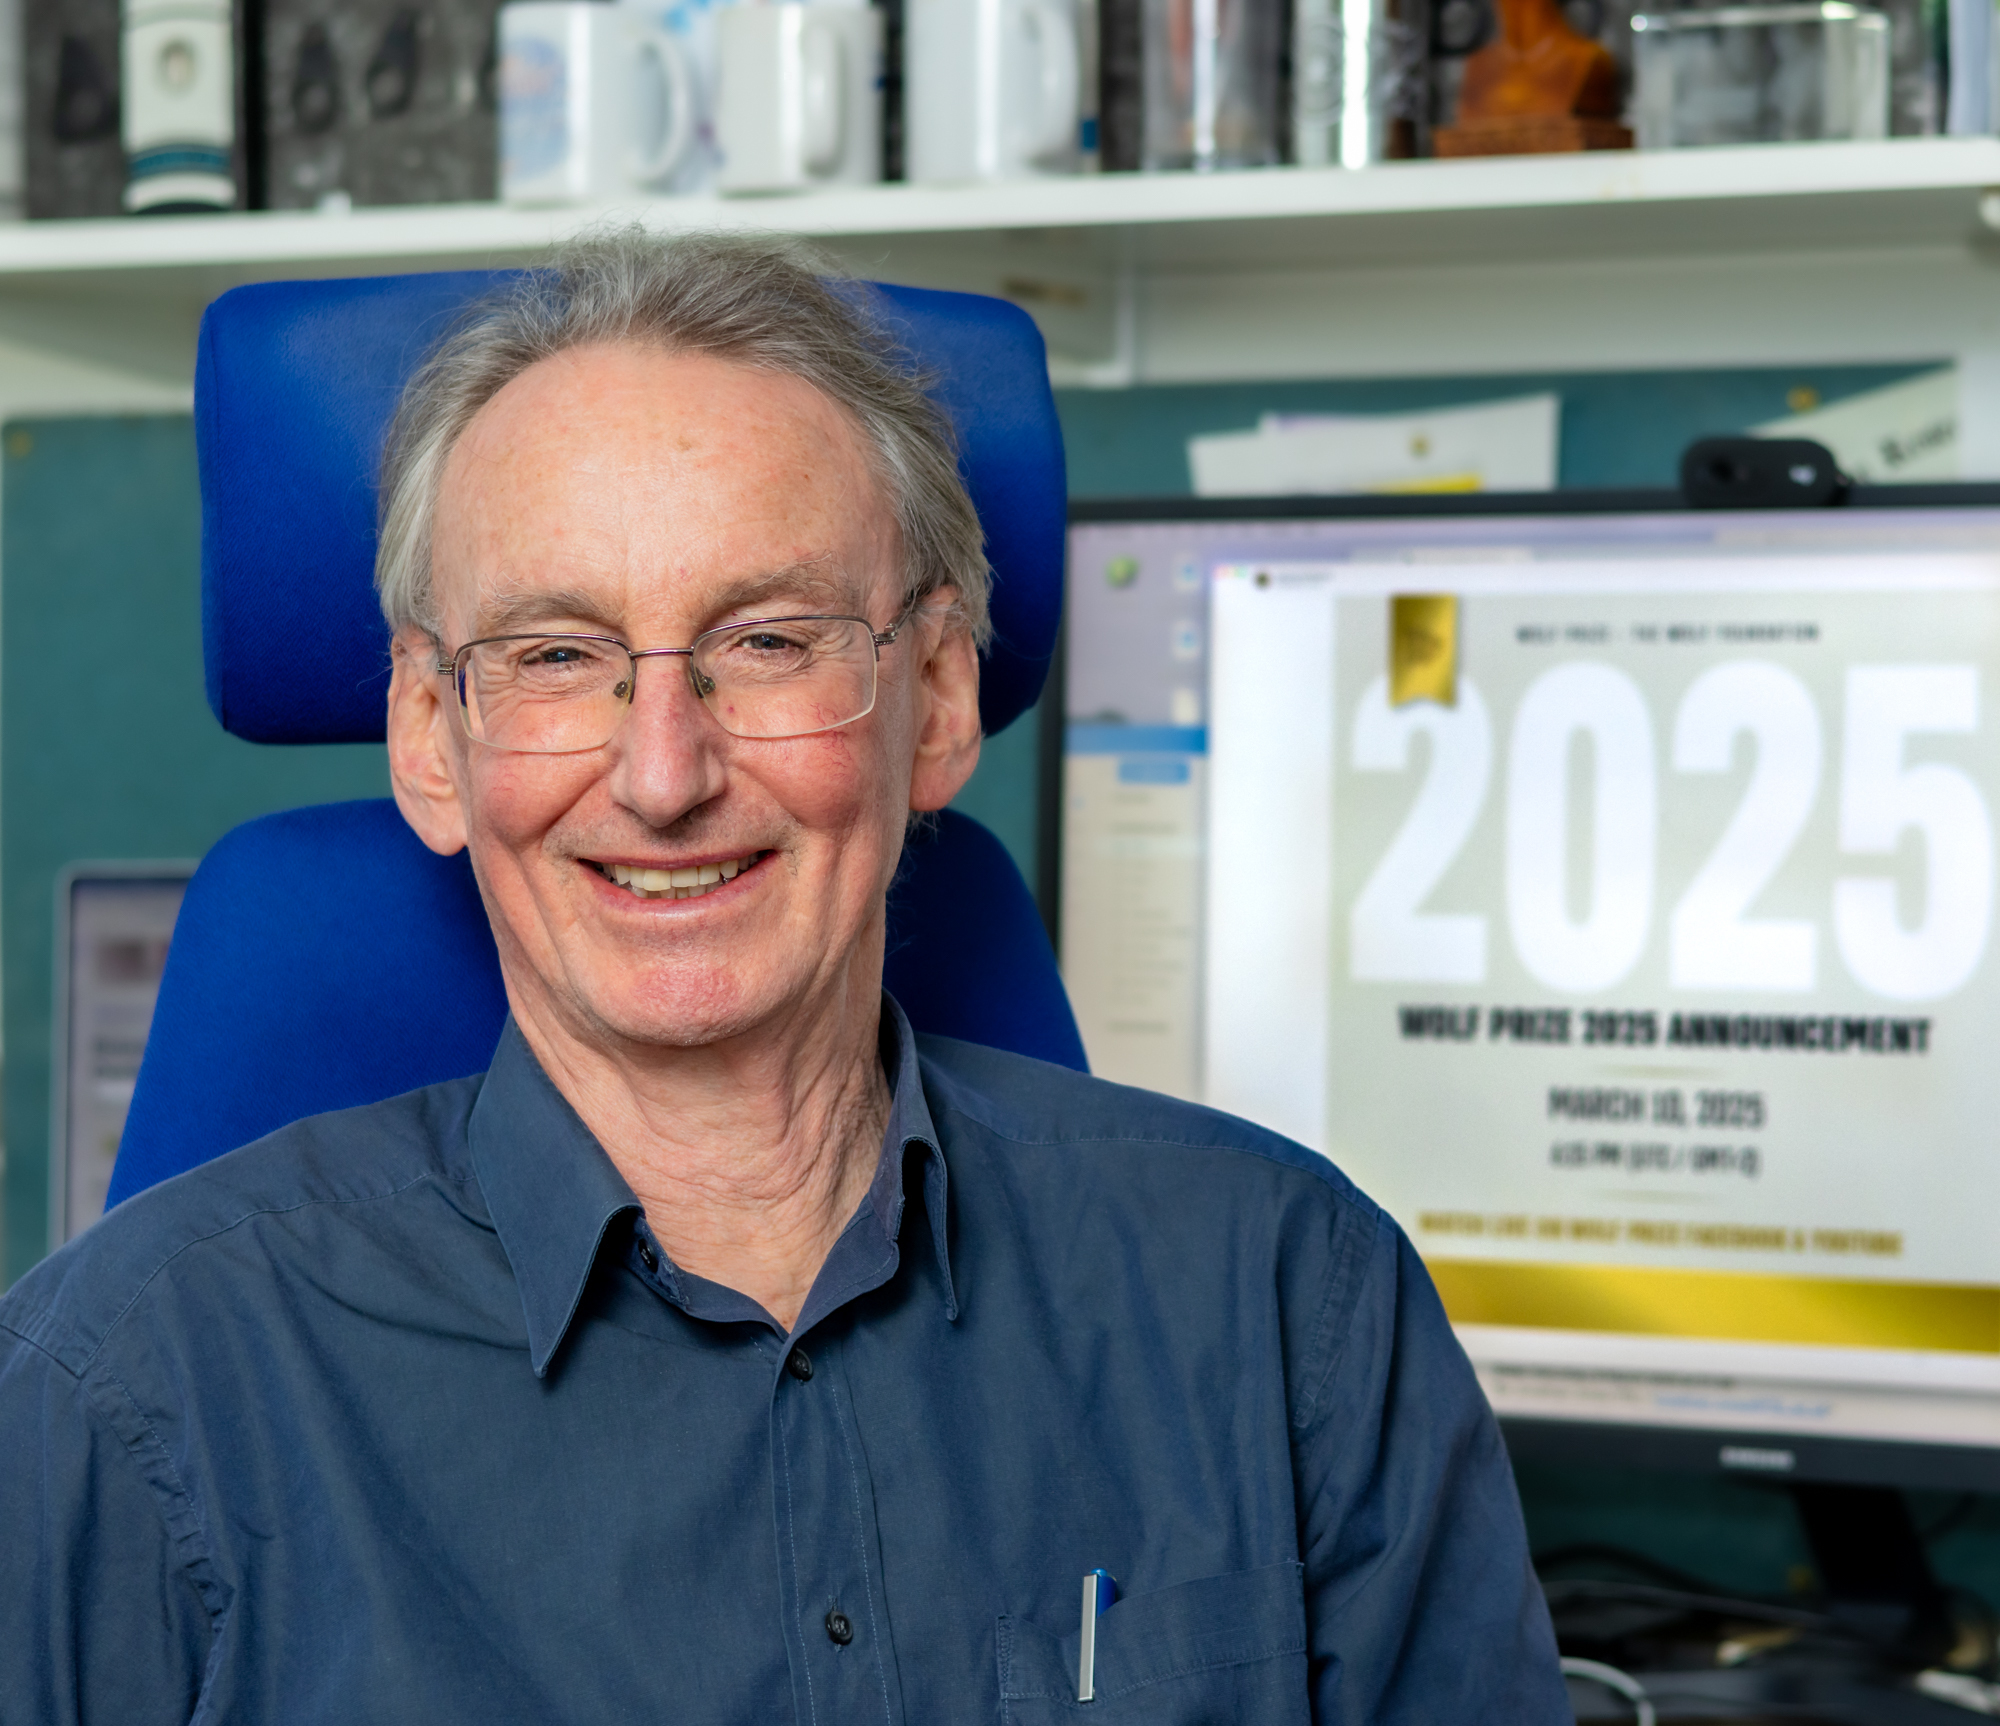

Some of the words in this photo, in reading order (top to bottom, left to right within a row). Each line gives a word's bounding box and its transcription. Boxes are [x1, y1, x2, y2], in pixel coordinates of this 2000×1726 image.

[1349, 660, 1995, 1001] 2025
[1399, 1005, 1478, 1040] WOLF
[1489, 1007, 1571, 1043] PRIZE
[1582, 1009, 1658, 1046] 2025
[1667, 1012, 1932, 1053] ANNOUNCEMENT
[1548, 1085, 1645, 1124] MARCH
[1696, 1089, 1766, 1130] 2025
